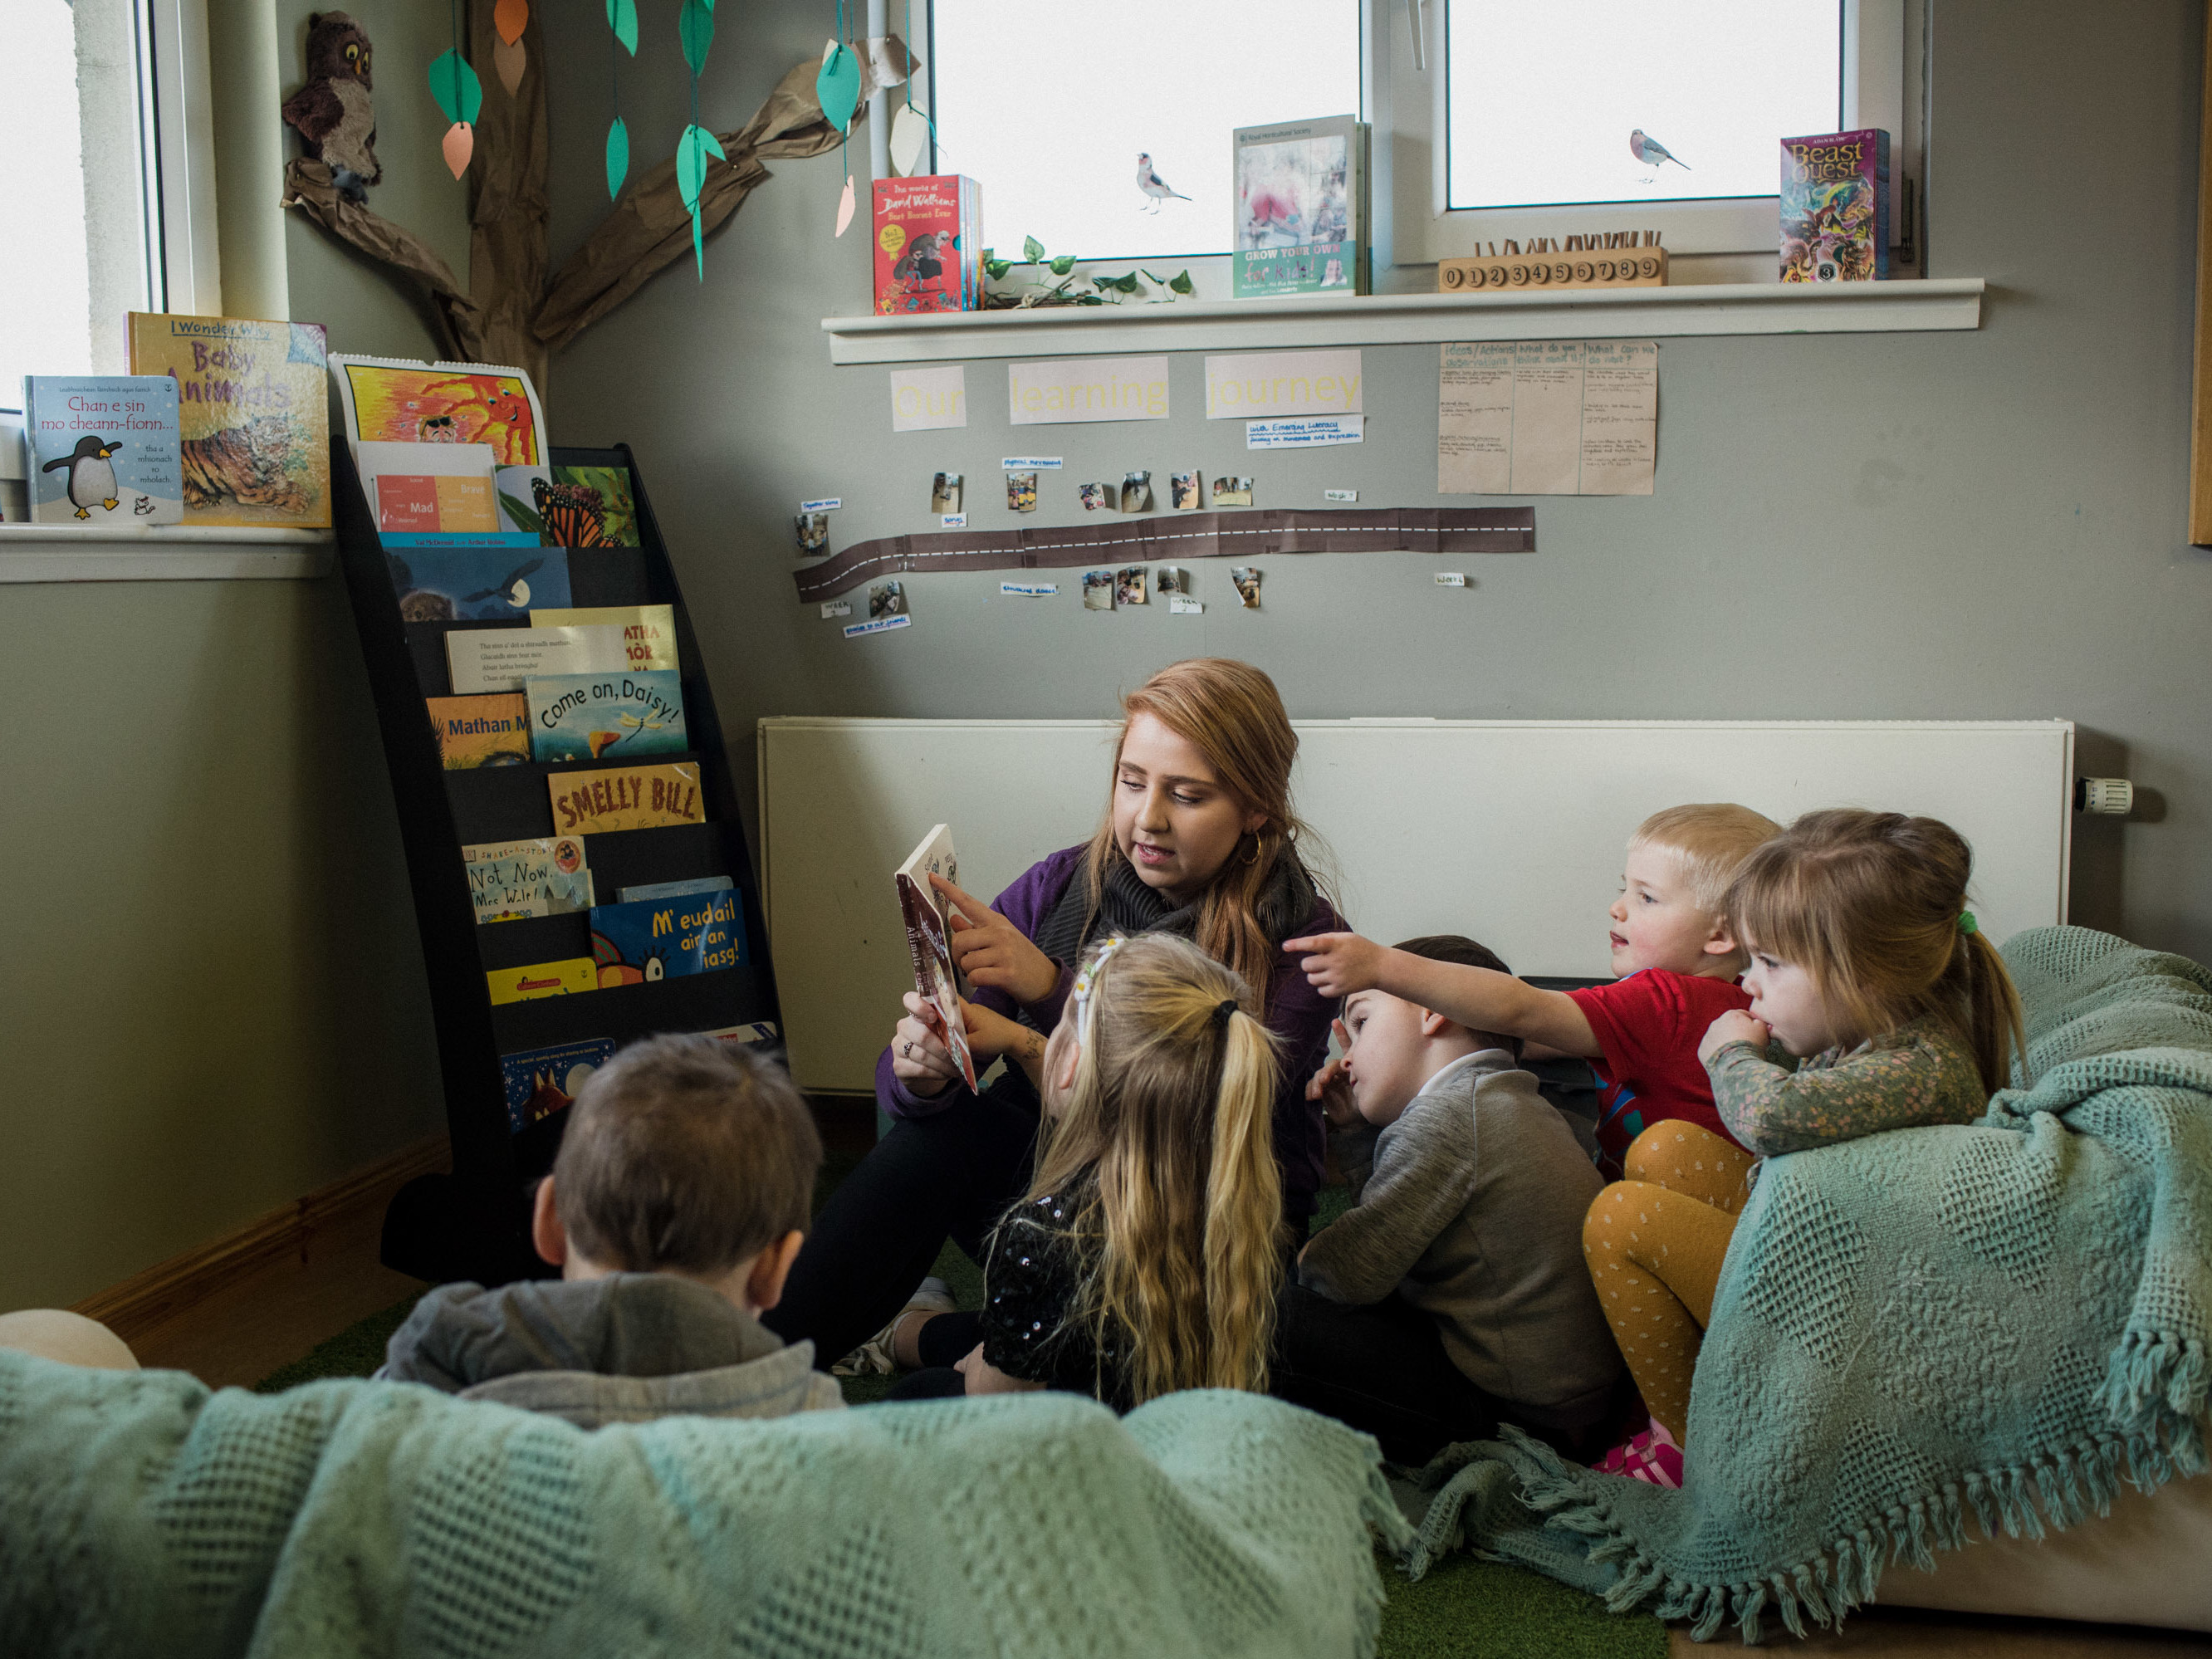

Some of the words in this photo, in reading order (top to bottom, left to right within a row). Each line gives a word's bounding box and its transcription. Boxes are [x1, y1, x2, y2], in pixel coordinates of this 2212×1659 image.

[1789, 140, 1866, 166] Beast
[1791, 160, 1863, 184] Quest
[894, 184, 907, 193] The
[931, 184, 938, 192] of
[878, 194, 912, 215] David
[913, 193, 957, 207] Walliams
[934, 208, 952, 218] Ever
[1245, 249, 1278, 261] GROW
[1281, 247, 1310, 258] YOUR
[1314, 244, 1340, 255] OWN
[1245, 262, 1270, 282] for
[1275, 257, 1314, 280] kids!
[1447, 271, 1454, 283] 0
[1471, 270, 1478, 283] 1
[1490, 269, 1499, 282] 2
[1514, 267, 1522, 280] 3
[1533, 266, 1542, 278] 4
[1556, 264, 1564, 277] 5
[1578, 264, 1586, 277] 6
[1599, 263, 1608, 276] 7
[1621, 262, 1629, 275] 8
[1642, 261, 1651, 273] 9
[171, 320, 174, 333] I
[179, 321, 234, 335] Wonder
[192, 340, 256, 377] Baby
[1520, 345, 1544, 354] What
[1549, 343, 1558, 353] do
[1588, 344, 1613, 355] What
[1621, 345, 1638, 354] can
[1642, 346, 1655, 355] we
[68, 396, 108, 413] Chan
[112, 403, 120, 413] e
[125, 399, 145, 413] sin
[894, 386, 964, 418] Our
[1013, 374, 1167, 415] learning
[1206, 372, 1360, 415] journey
[42, 420, 65, 431] mo
[69, 414, 174, 430] cheann-fionn...
[138, 455, 173, 463] mhionach
[461, 483, 485, 494] Brave
[410, 502, 434, 513] Mad
[541, 688, 585, 729] Come
[593, 681, 619, 700] on,
[622, 678, 680, 724] Daisy!
[448, 715, 511, 736] Mathan
[556, 775, 643, 829] SMELLY
[651, 776, 695, 820] BILL
[470, 862, 503, 893] Not
[680, 897, 736, 930] eudail
[681, 933, 701, 951] air
[707, 930, 726, 945] an
[907, 926, 921, 967] Animals
[702, 937, 739, 969] iasg!
